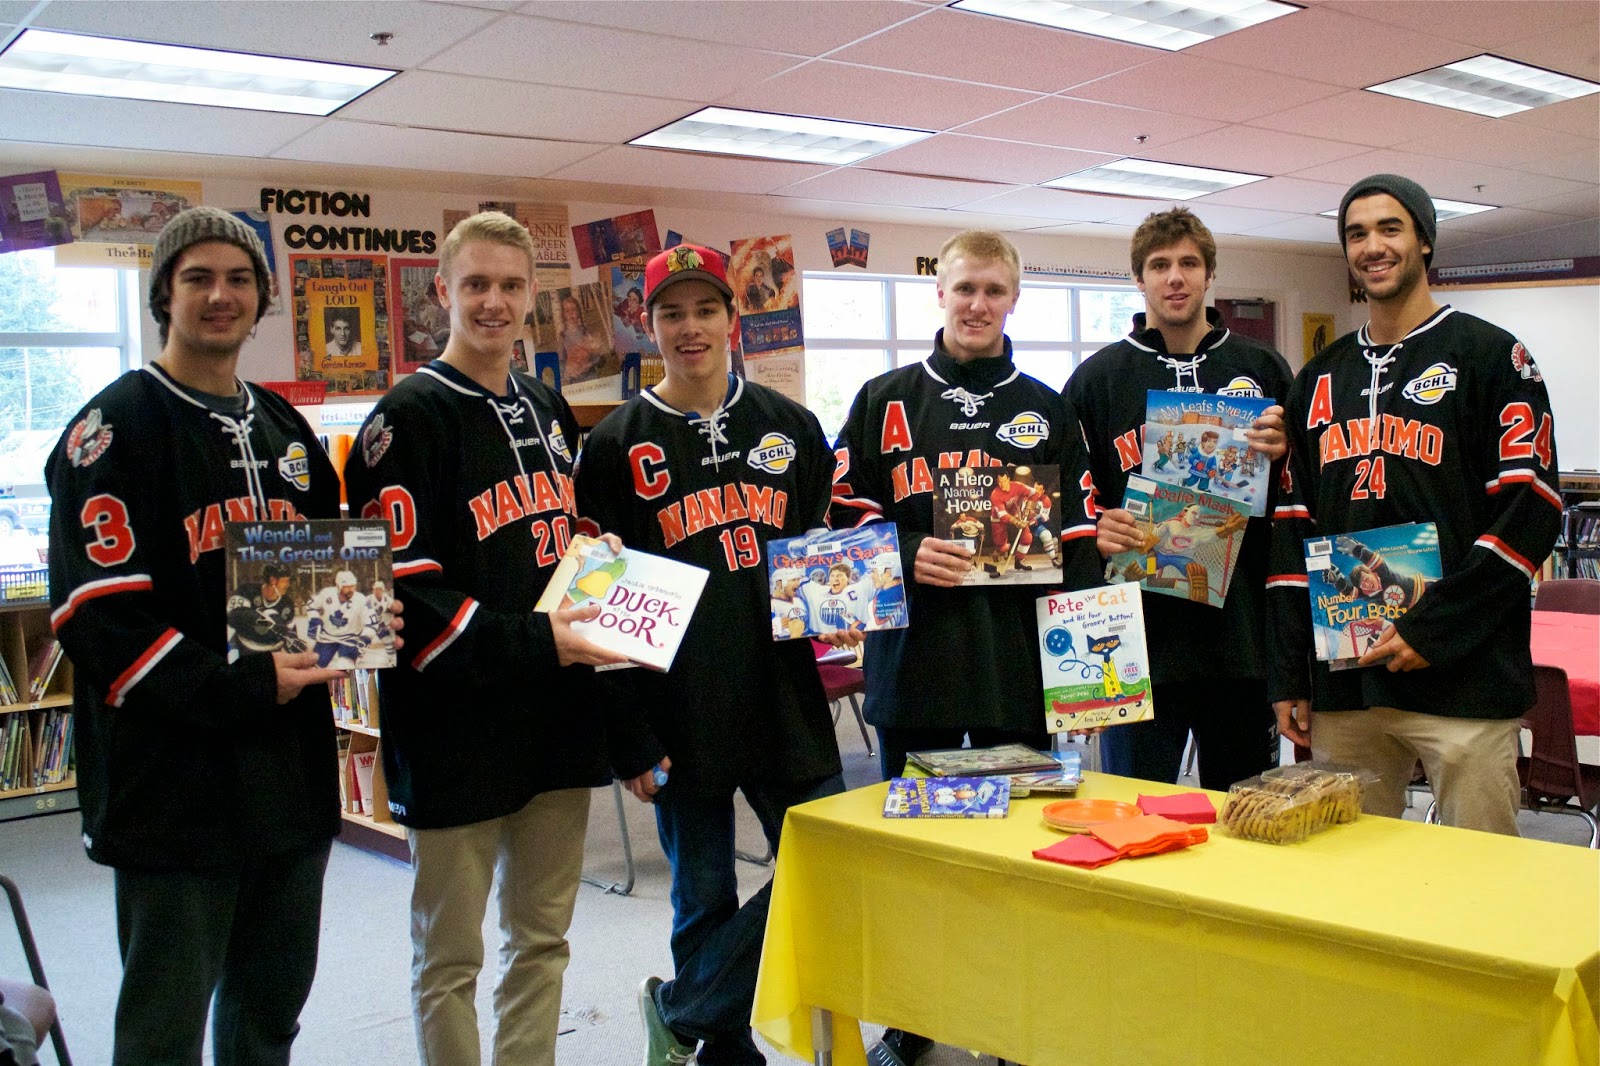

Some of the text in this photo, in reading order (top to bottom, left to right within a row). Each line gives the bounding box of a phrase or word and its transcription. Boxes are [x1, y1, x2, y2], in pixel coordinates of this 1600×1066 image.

[260, 188, 370, 217] FICTION
[284, 224, 437, 254] CONTINUES
[106, 247, 154, 258] The Ha
[536, 251, 567, 260] ABLES
[312, 281, 368, 293] Laugh Out
[325, 295, 357, 305] LOUD
[1413, 377, 1450, 391] BCHL
[1307, 374, 1333, 429] A
[1160, 400, 1258, 424] My Leafs Sweate
[881, 401, 913, 454] A
[949, 421, 990, 431] BAUER
[1009, 424, 1044, 435] BCHL
[1499, 401, 1552, 471] 24
[701, 450, 741, 467] BAUER
[759, 446, 791, 460] BCHL
[628, 441, 671, 500] C
[1351, 456, 1387, 500] 24
[940, 472, 994, 487] A Hero
[944, 487, 984, 499] Named
[947, 499, 992, 514] Howe
[81, 493, 136, 567] 3
[243, 523, 333, 544] Wendel and
[531, 516, 573, 568] 20
[719, 525, 760, 572] 19
[236, 545, 379, 563] The Great One
[774, 544, 894, 569] Gretzky's Game
[848, 591, 857, 601] C
[1048, 589, 1128, 615] Pete the Cat
[1318, 593, 1357, 609] Number
[608, 585, 680, 626] DUCK
[1062, 617, 1075, 625] and
[1076, 614, 1086, 622] His
[1082, 612, 1134, 629] Groovy Buttons
